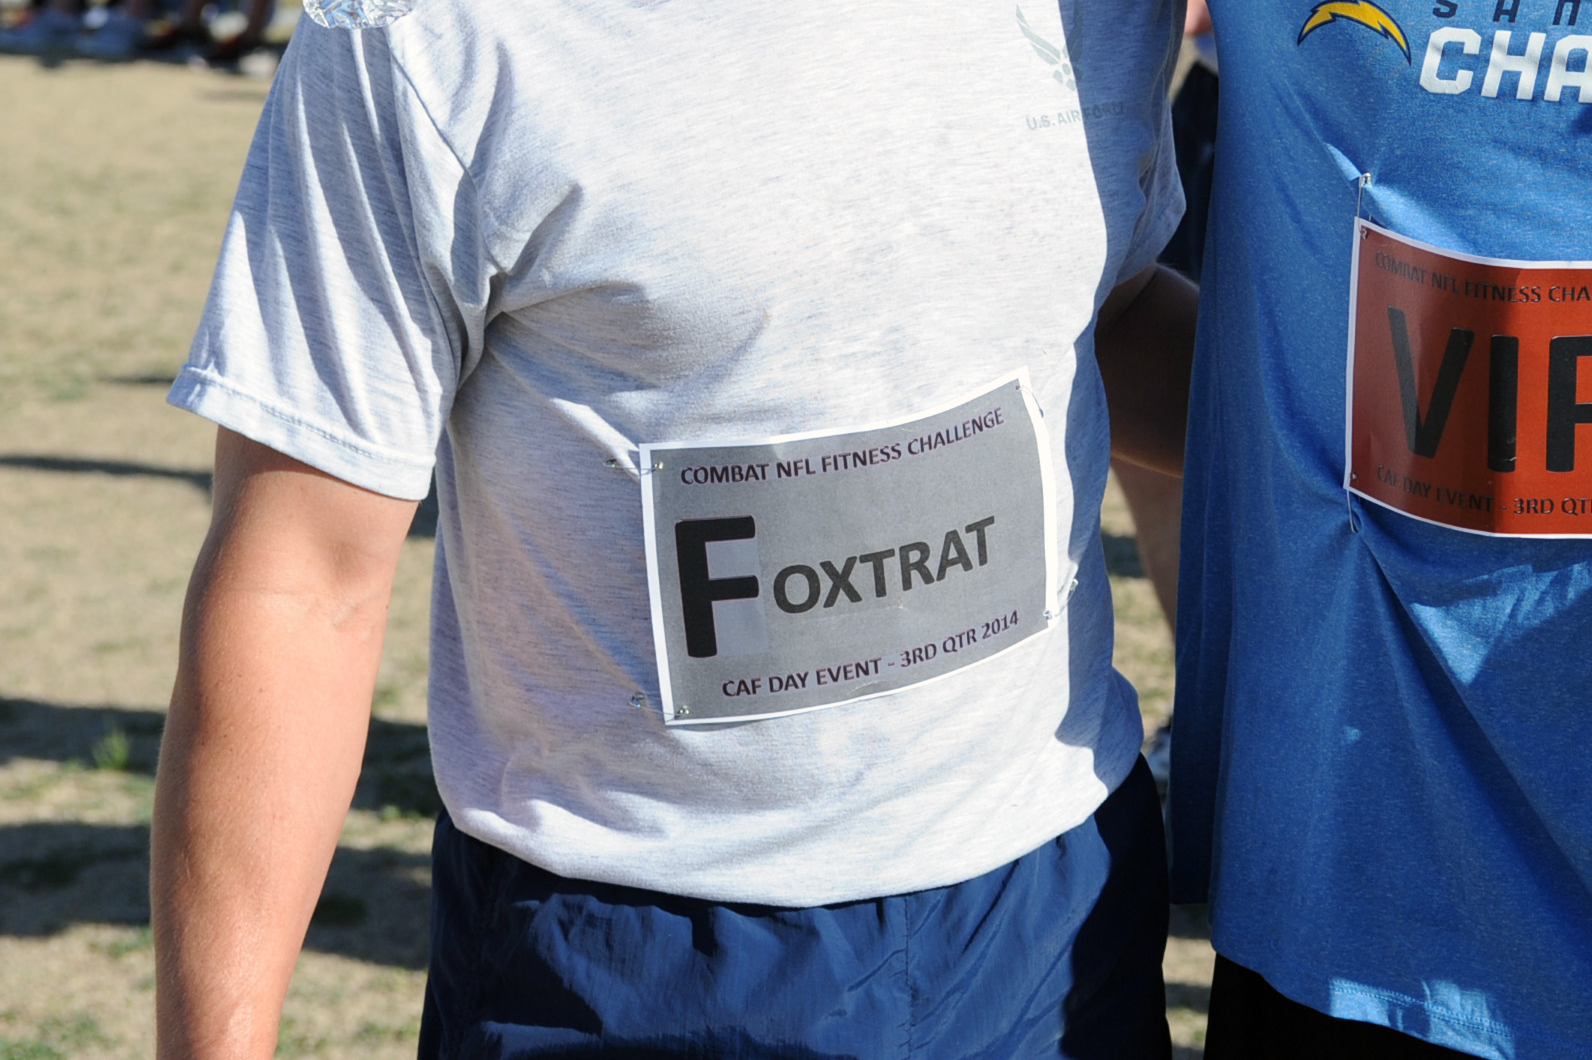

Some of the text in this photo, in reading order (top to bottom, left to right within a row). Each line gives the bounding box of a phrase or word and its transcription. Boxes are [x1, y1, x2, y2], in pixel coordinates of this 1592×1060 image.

[1025, 114, 1056, 131] U.S.
[1057, 109, 1082, 125] AIR
[1375, 250, 1427, 285] COMBAT
[1432, 271, 1461, 296] NFL
[1464, 279, 1542, 304] FITNESS
[680, 407, 1005, 485] COMBAT NFL FITNESS CHALLENGE
[1377, 464, 1400, 487] CAF
[1403, 476, 1433, 499] DAY
[1437, 487, 1495, 512] EVENT
[1513, 497, 1555, 515] 3RD
[674, 515, 995, 658] FOXTRAT
[722, 678, 762, 697] CAF
[768, 672, 810, 693] DAY
[816, 658, 882, 686] EVENT
[900, 643, 938, 668] 3RD
[942, 628, 978, 655] QTR
[981, 610, 1020, 640] 2014
